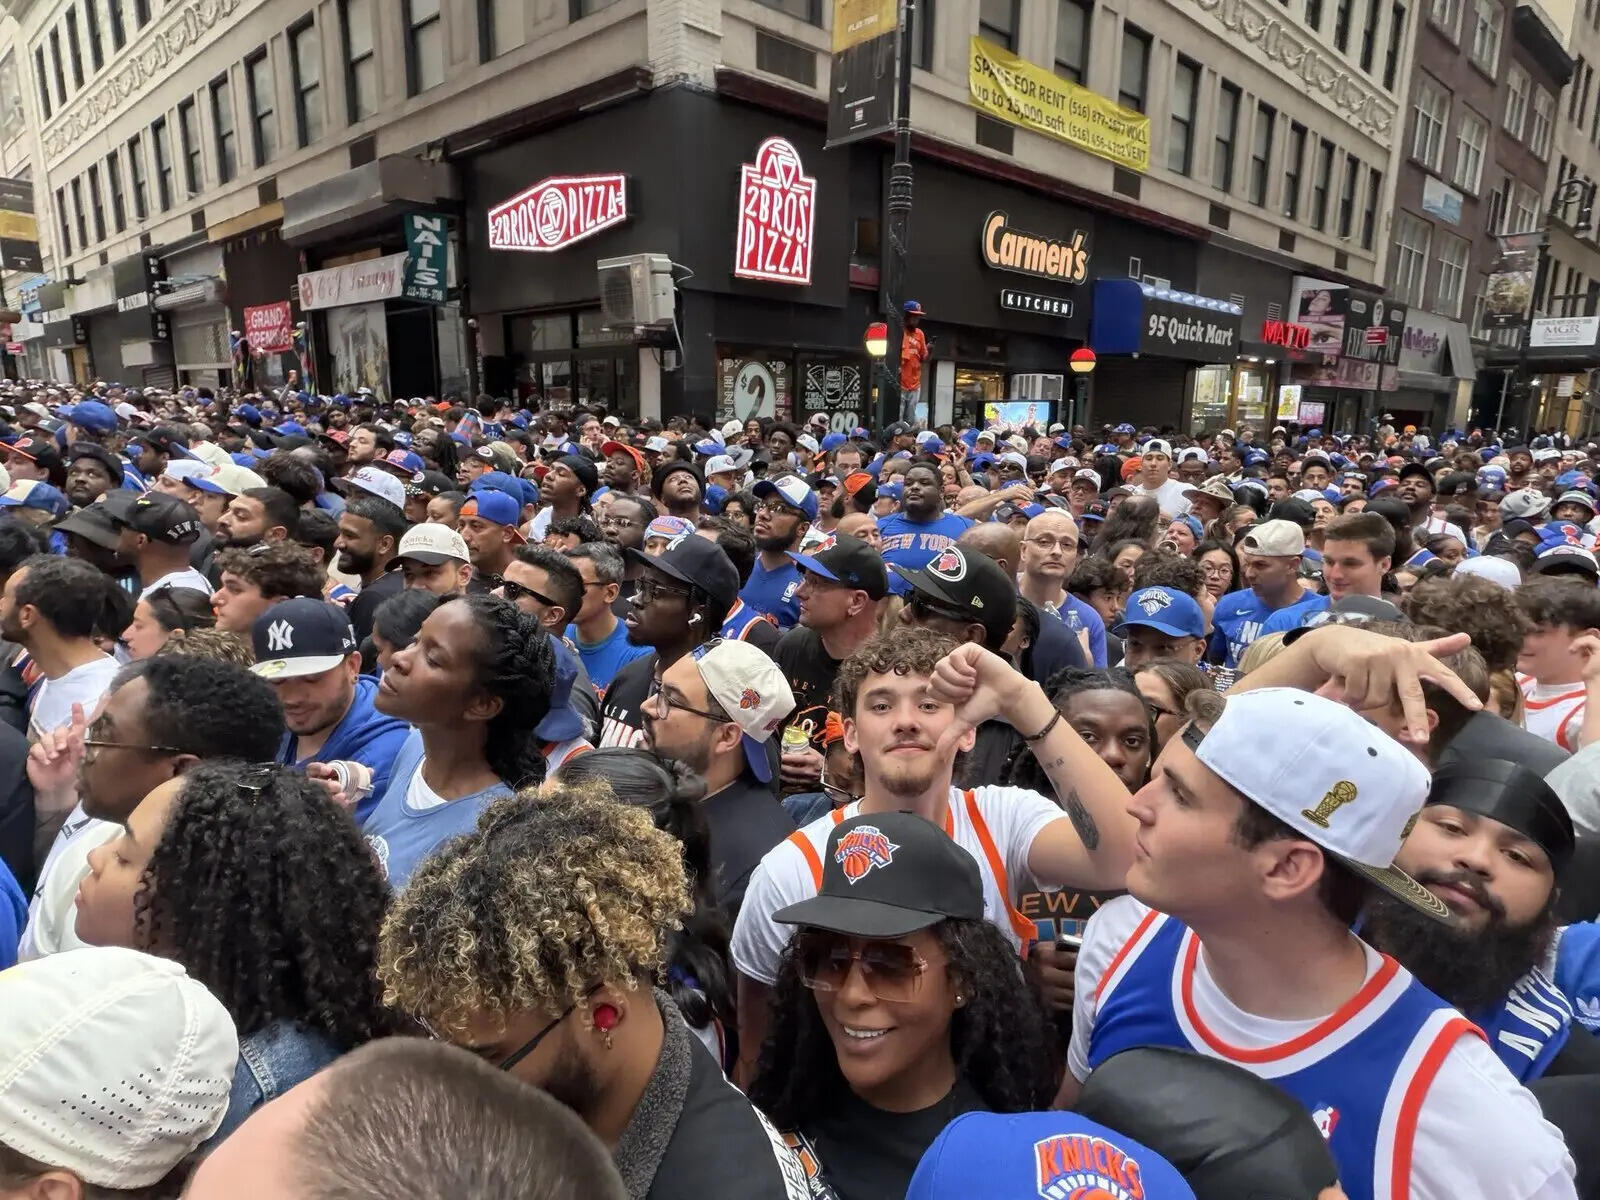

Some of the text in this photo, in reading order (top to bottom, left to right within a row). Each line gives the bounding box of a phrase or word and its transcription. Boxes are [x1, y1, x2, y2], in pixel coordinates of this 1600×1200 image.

[974, 54, 1012, 86] SPACE
[1014, 73, 1036, 97] FOR
[1038, 85, 1066, 111] RENT
[974, 83, 989, 106] up
[992, 89, 1003, 108] to
[568, 184, 618, 236] PIZZA
[413, 214, 443, 286] NAILS
[743, 218, 803, 275] PIZZA
[986, 215, 1087, 280] Carmen's
[250, 307, 283, 329] GRAND
[1007, 293, 1068, 314] KITCHEN
[1149, 314, 1233, 347] 95 Quick Mart
[1038, 1136, 1145, 1200] KNICKS
